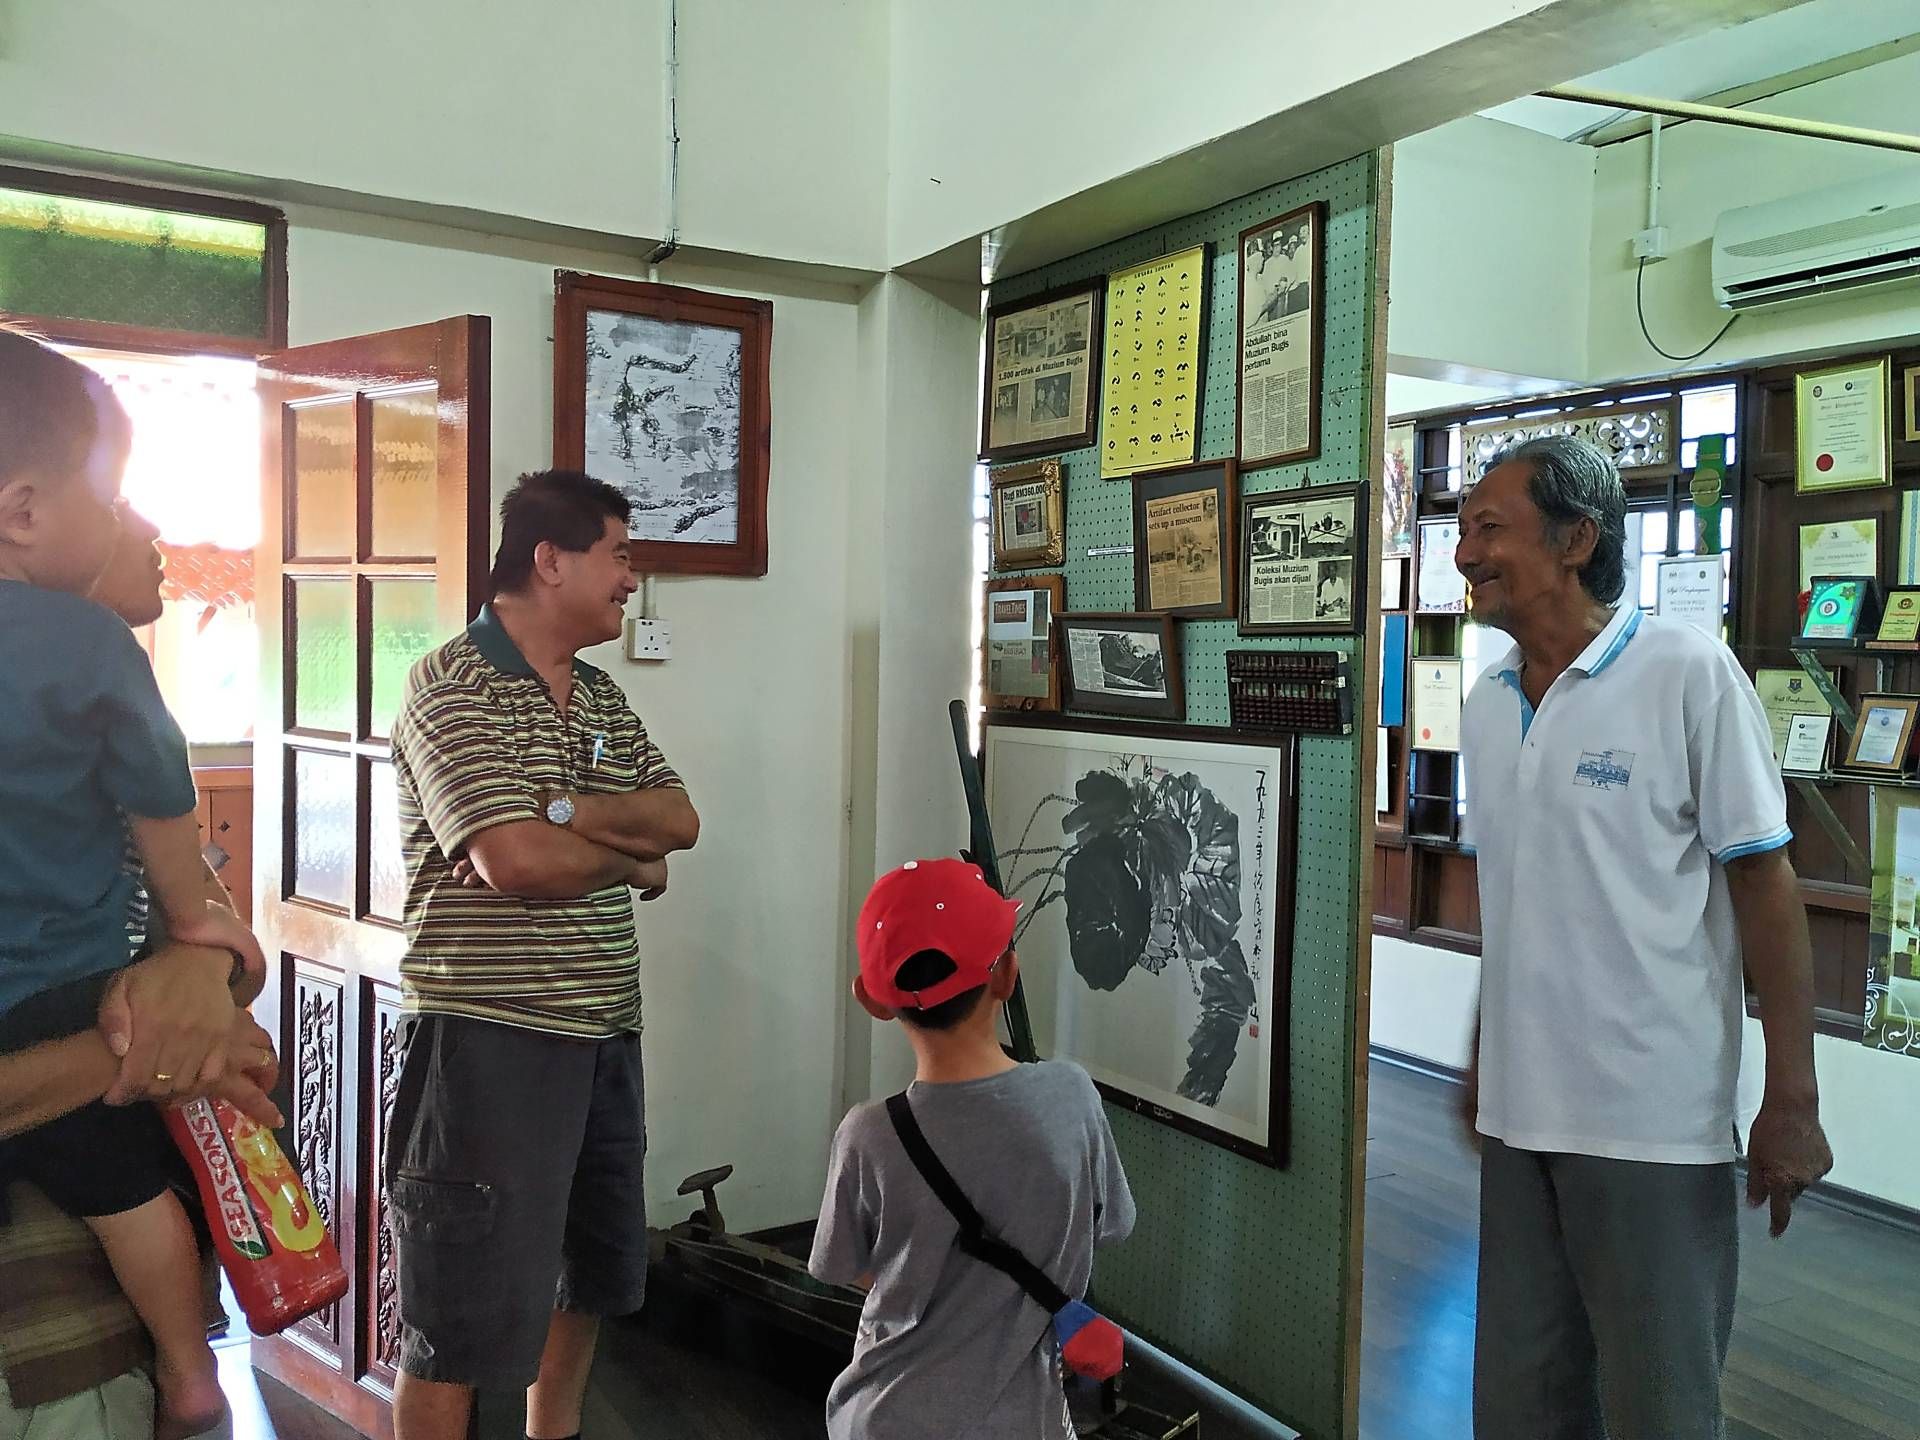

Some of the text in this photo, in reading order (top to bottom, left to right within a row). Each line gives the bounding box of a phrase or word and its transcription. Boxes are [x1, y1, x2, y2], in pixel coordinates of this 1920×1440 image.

[1245, 329, 1288, 348] Abdullah bina
[1245, 340, 1289, 359] Muzium Bugis
[1042, 360, 1065, 370] Muzium
[1066, 356, 1084, 367] Bugis
[1245, 358, 1271, 373] pertama
[1148, 502, 1200, 518] Artifact collector
[1148, 522, 1160, 530] sets
[1161, 521, 1170, 530] up
[1175, 515, 1202, 526] museum
[1256, 564, 1309, 575] Koleksi Muzium
[1254, 576, 1273, 586] Bugis
[1274, 576, 1290, 584] akan
[191, 1115, 251, 1238] SEASONS
